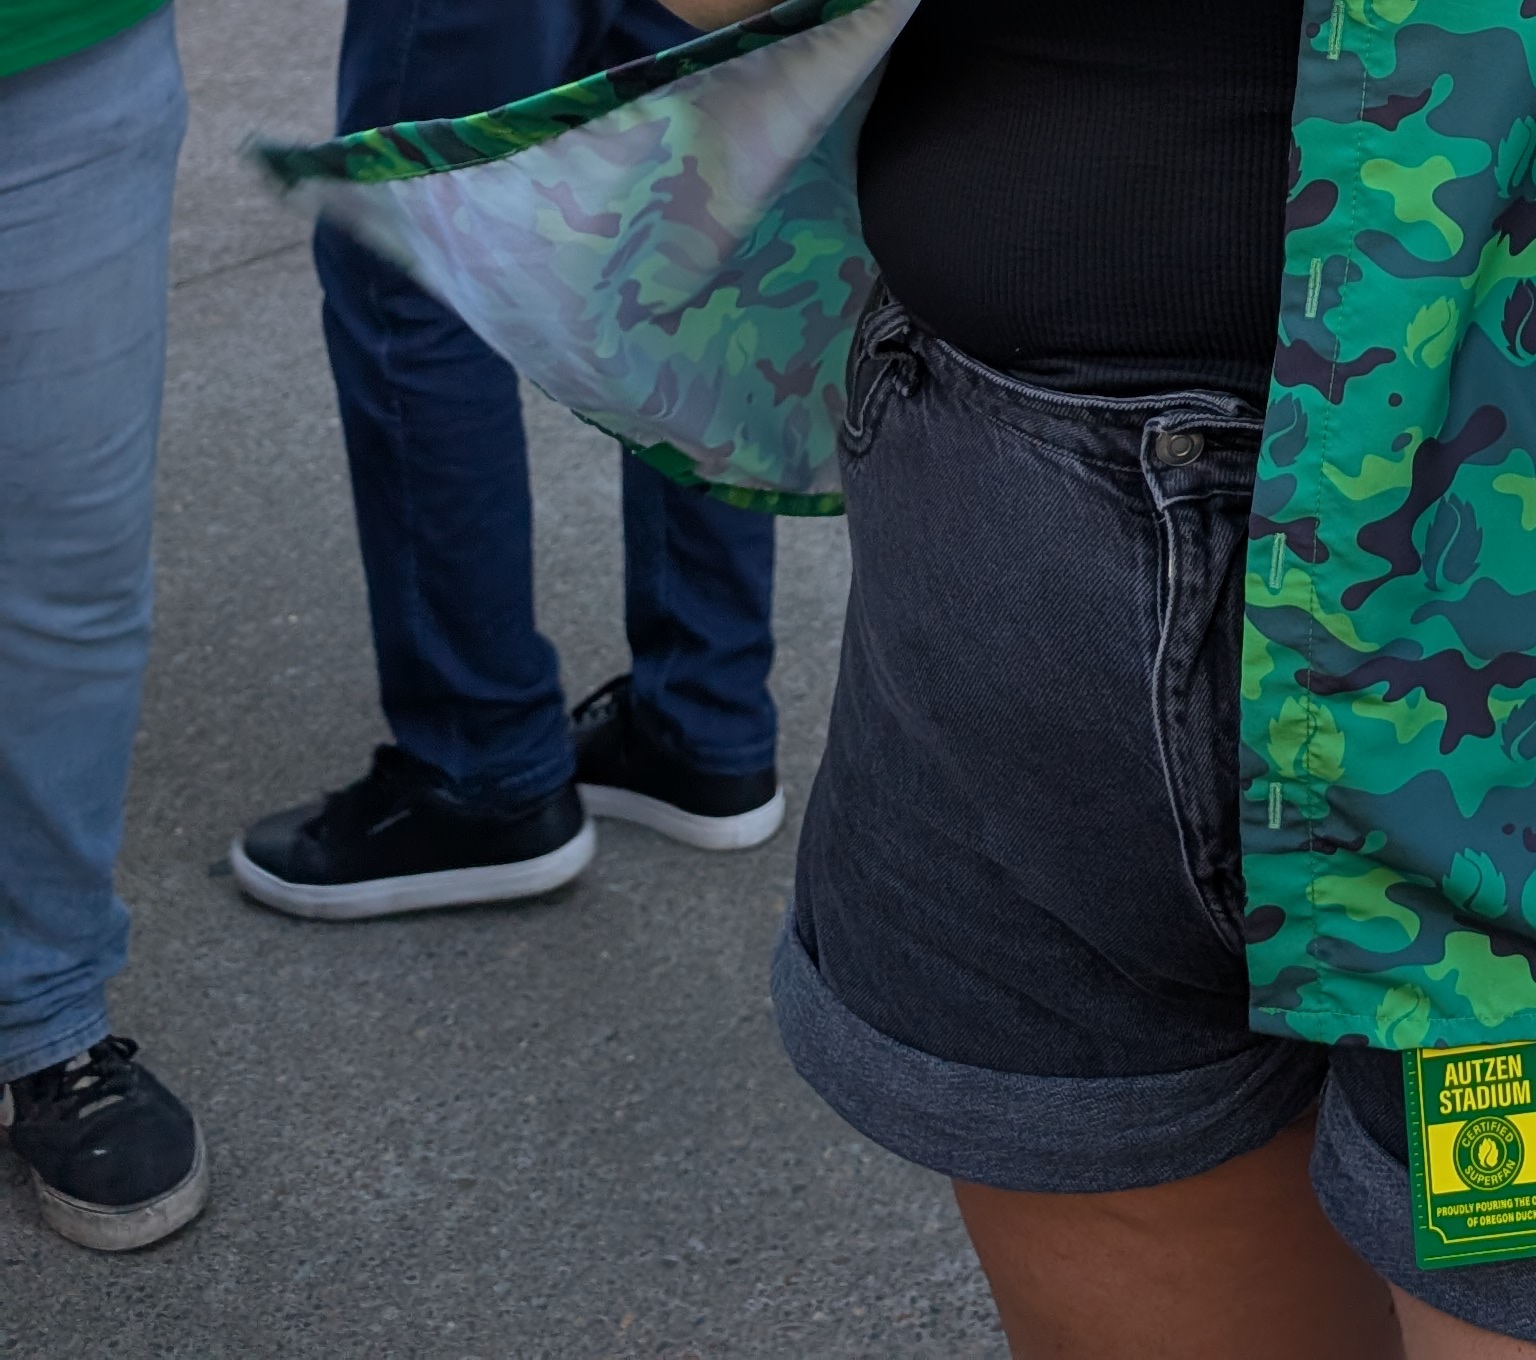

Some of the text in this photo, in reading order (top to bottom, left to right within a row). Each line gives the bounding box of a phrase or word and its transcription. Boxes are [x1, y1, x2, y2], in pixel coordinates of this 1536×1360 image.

[1444, 1054, 1522, 1088] AUTZEN
[1439, 1079, 1531, 1114] STADIUM
[1462, 1121, 1514, 1147] CERTIFIED
[1465, 1159, 1516, 1186] SUPERFAN
[1436, 1203, 1473, 1217] PROUDLY
[1475, 1198, 1513, 1212] POURING
[1514, 1196, 1530, 1207] THE
[1467, 1217, 1478, 1228] OF
[1479, 1211, 1514, 1227] OREGON
